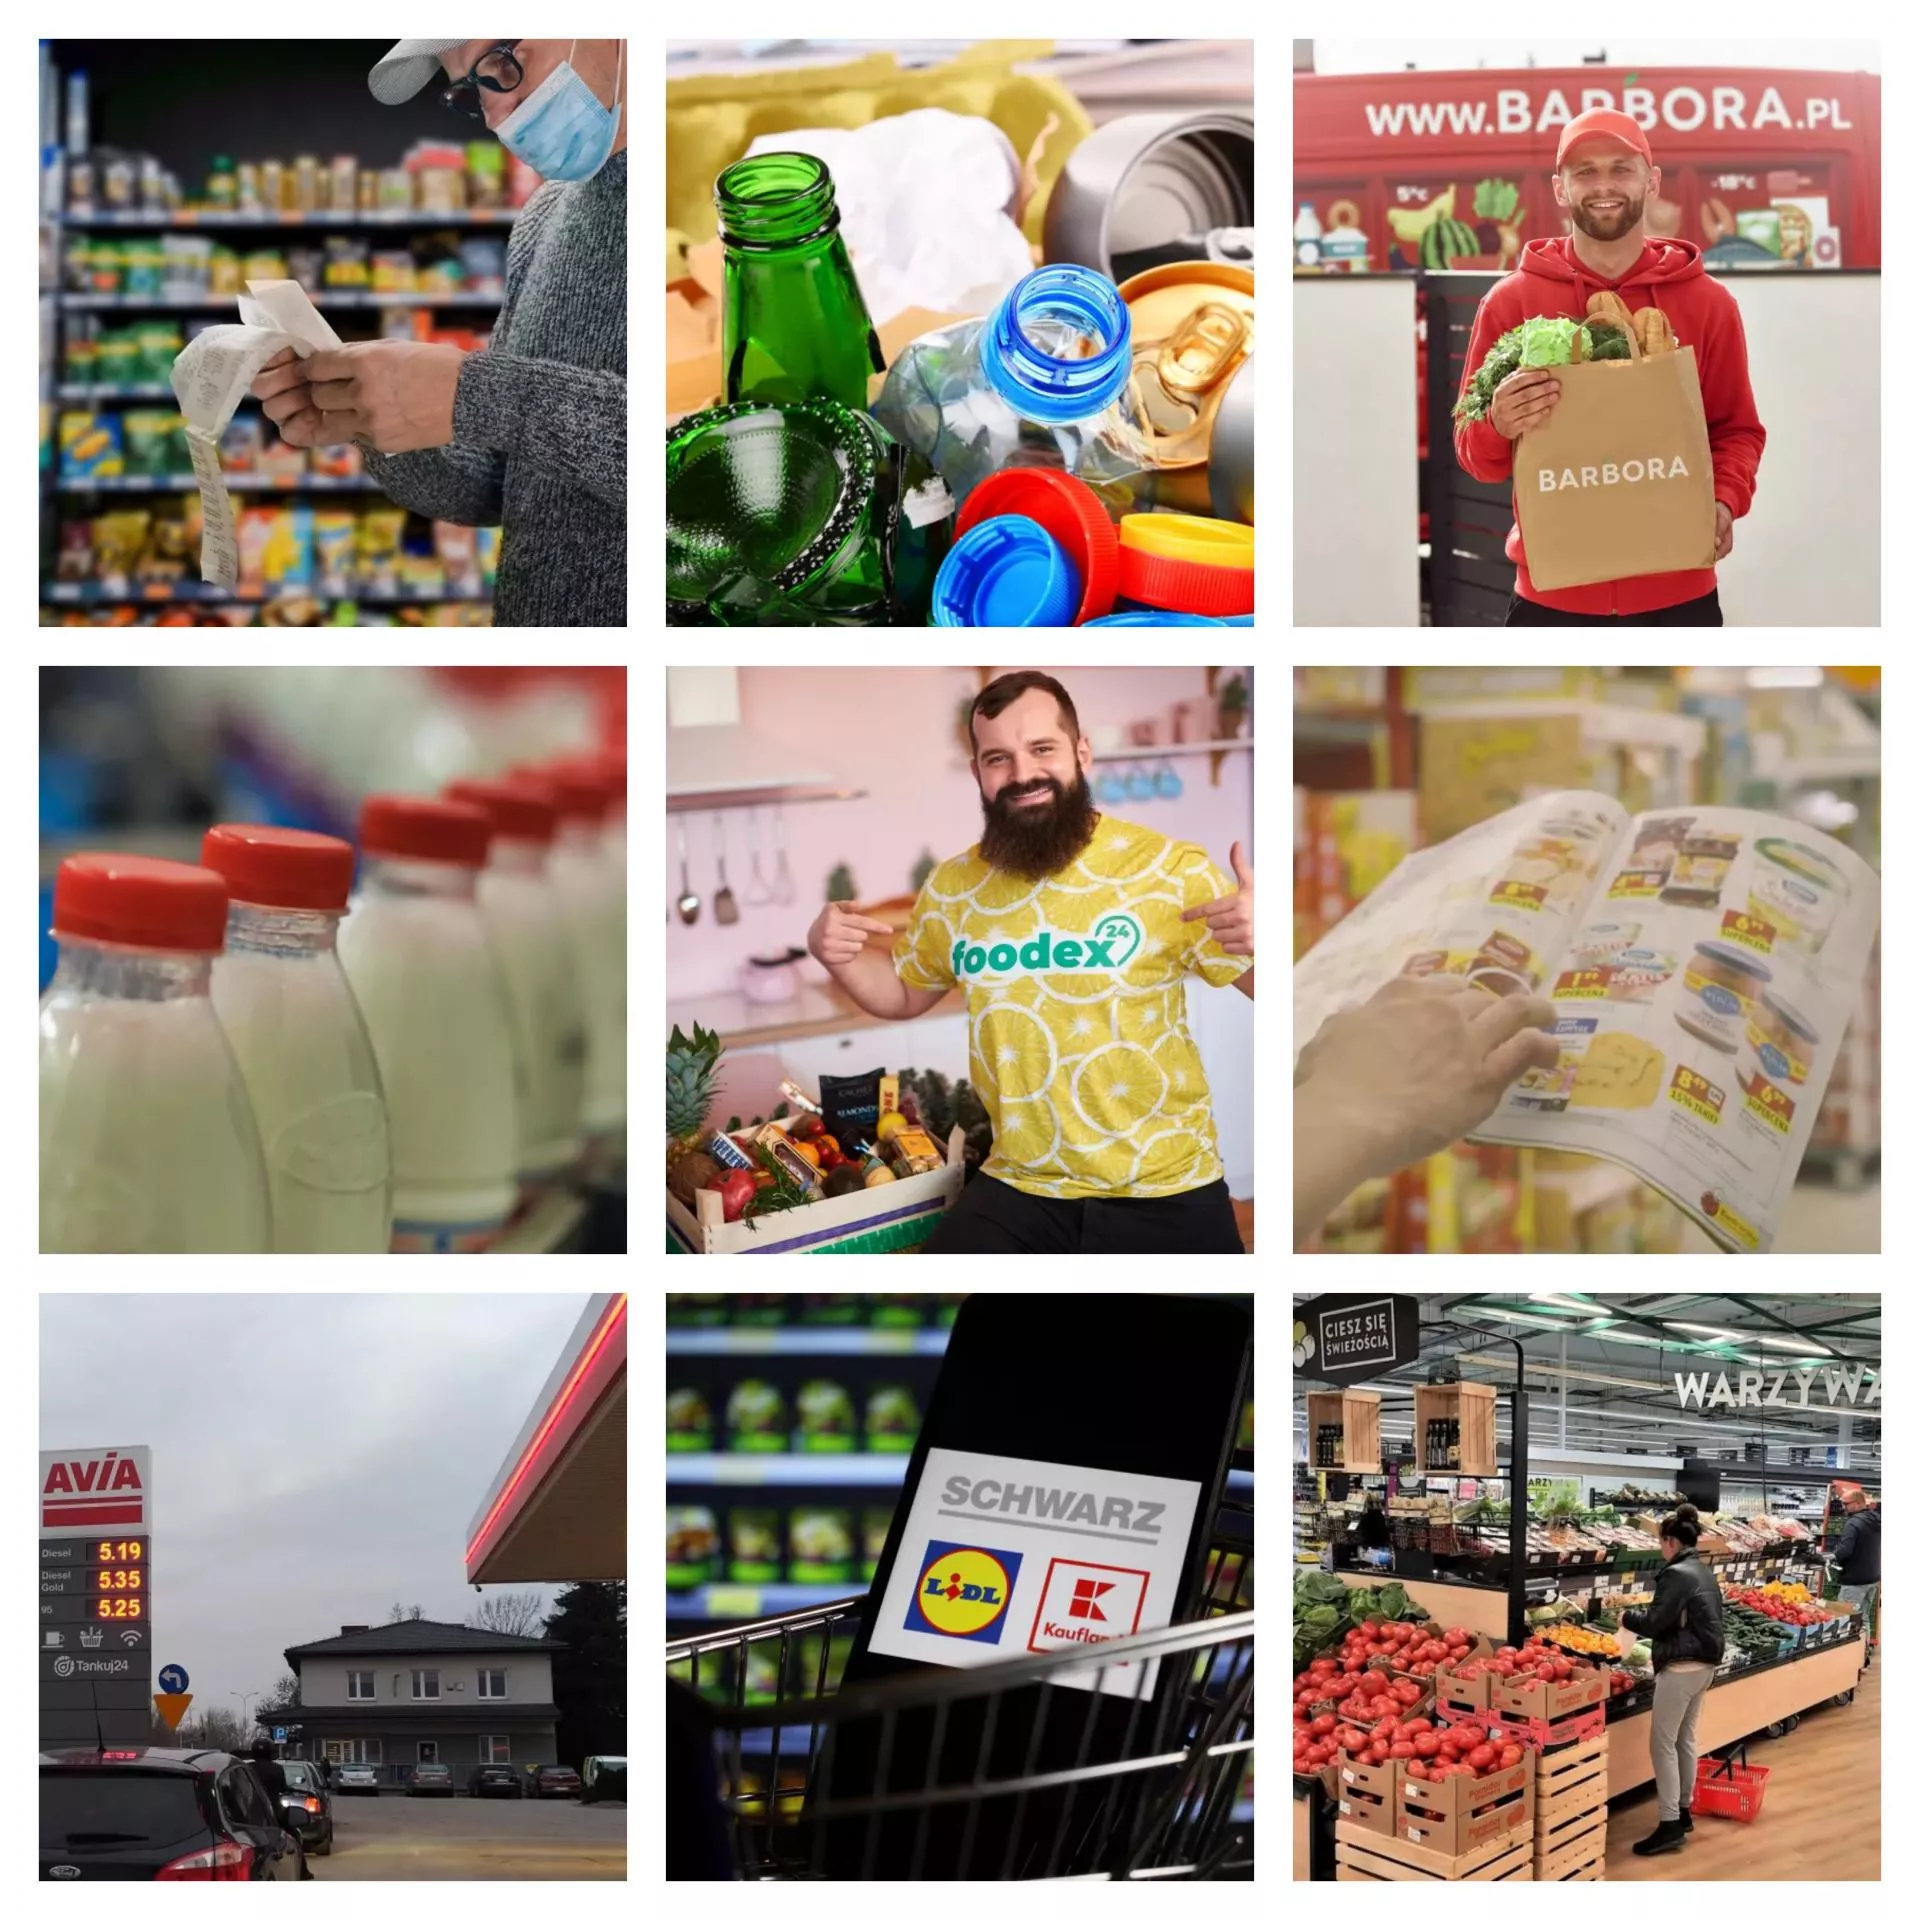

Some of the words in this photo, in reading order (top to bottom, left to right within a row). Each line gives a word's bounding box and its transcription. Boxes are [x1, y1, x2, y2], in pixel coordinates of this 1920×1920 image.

[1538, 455, 1689, 492] BARBORA
[1325, 1318, 1361, 1339] CIESZ
[1365, 1313, 1388, 1333] SIĘ
[1326, 1334, 1390, 1356] ŚWIEŻOŚCIĄ
[941, 1476, 1166, 1534] SCHWARZ
[41, 1549, 71, 1558] Diesel
[99, 1542, 141, 1560] 5.19
[41, 1571, 71, 1580] Diesel
[99, 1570, 141, 1589] 5.35
[41, 1583, 64, 1592] Gold
[41, 1605, 53, 1614] 95
[98, 1599, 141, 1617] 5.25
[76, 1659, 128, 1673] Tankuj24
